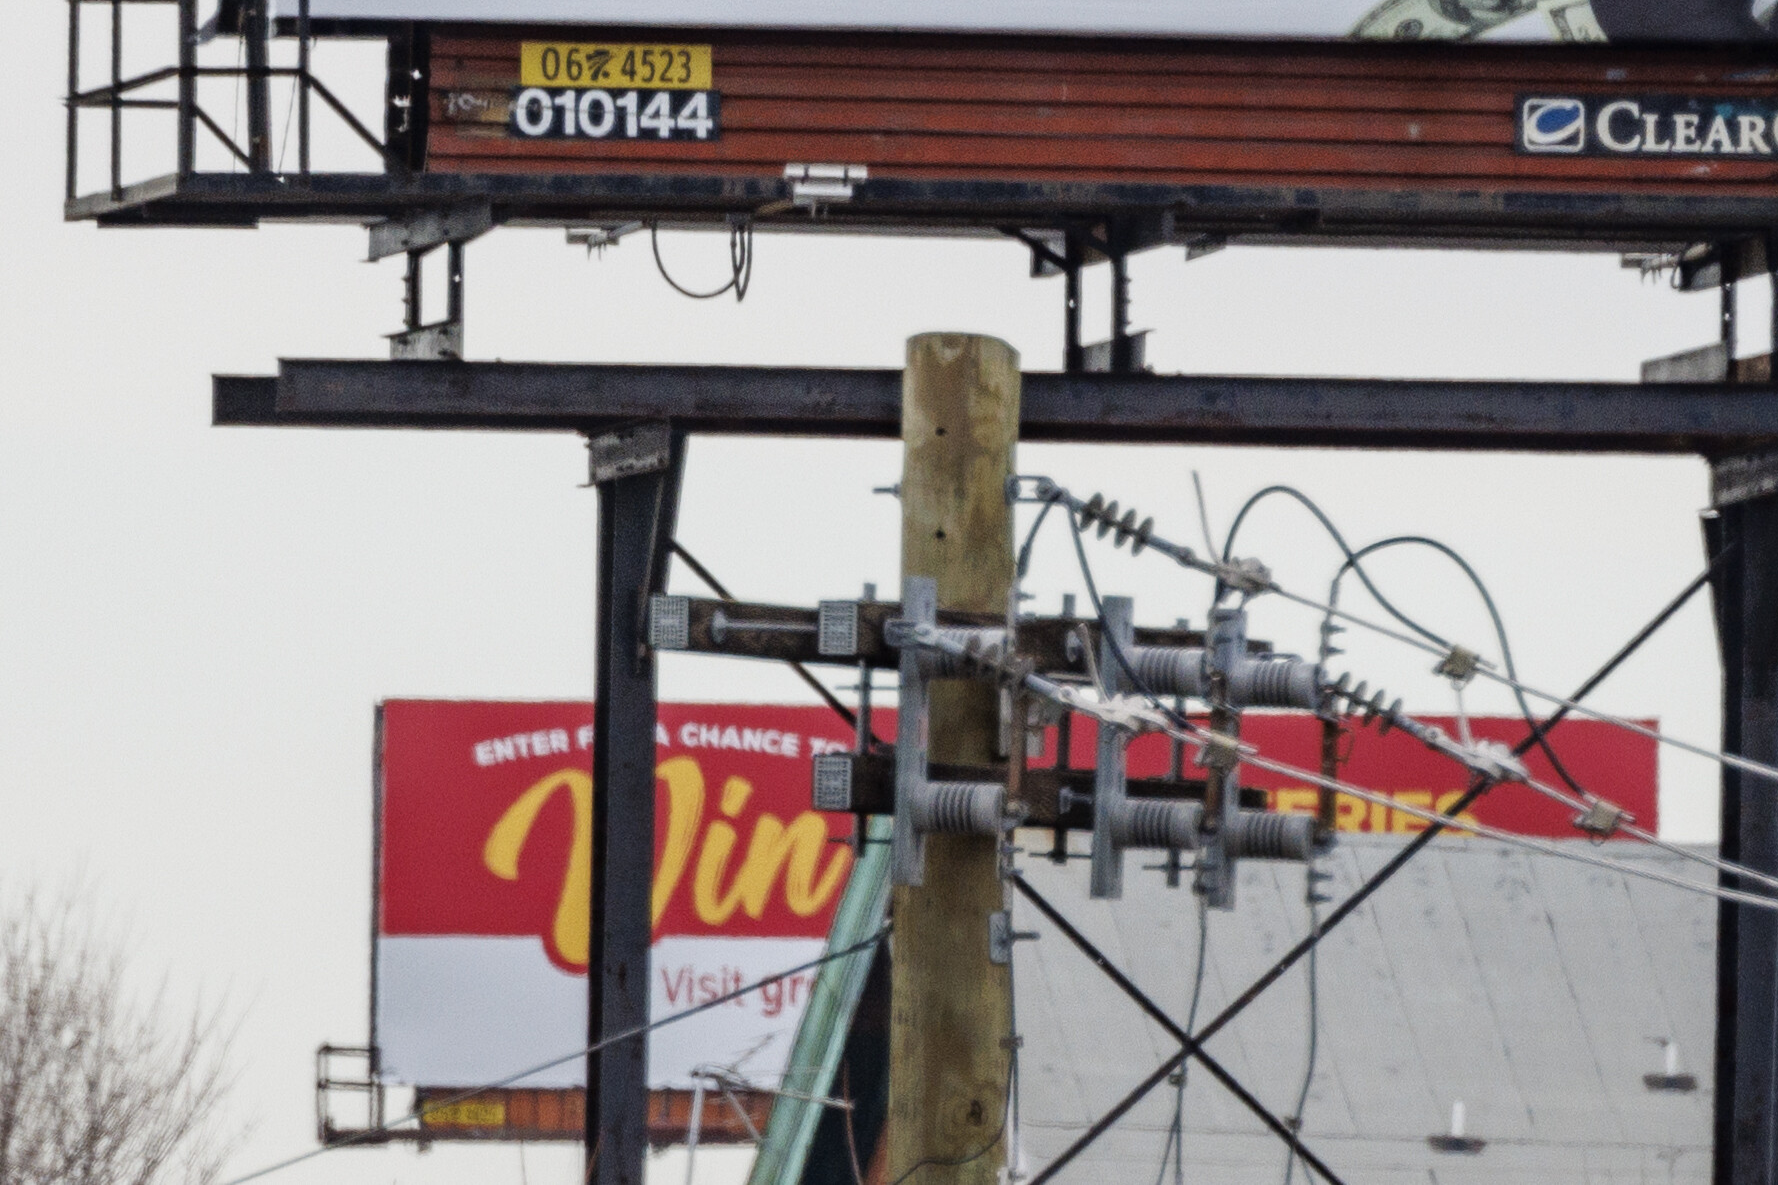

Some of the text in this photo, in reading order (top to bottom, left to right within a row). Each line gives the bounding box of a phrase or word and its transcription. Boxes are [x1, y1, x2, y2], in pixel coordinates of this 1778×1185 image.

[515, 88, 713, 138] 010144
[474, 728, 569, 767] ENTER
[680, 722, 799, 758] CHANCE
[661, 964, 745, 1007] Visit
